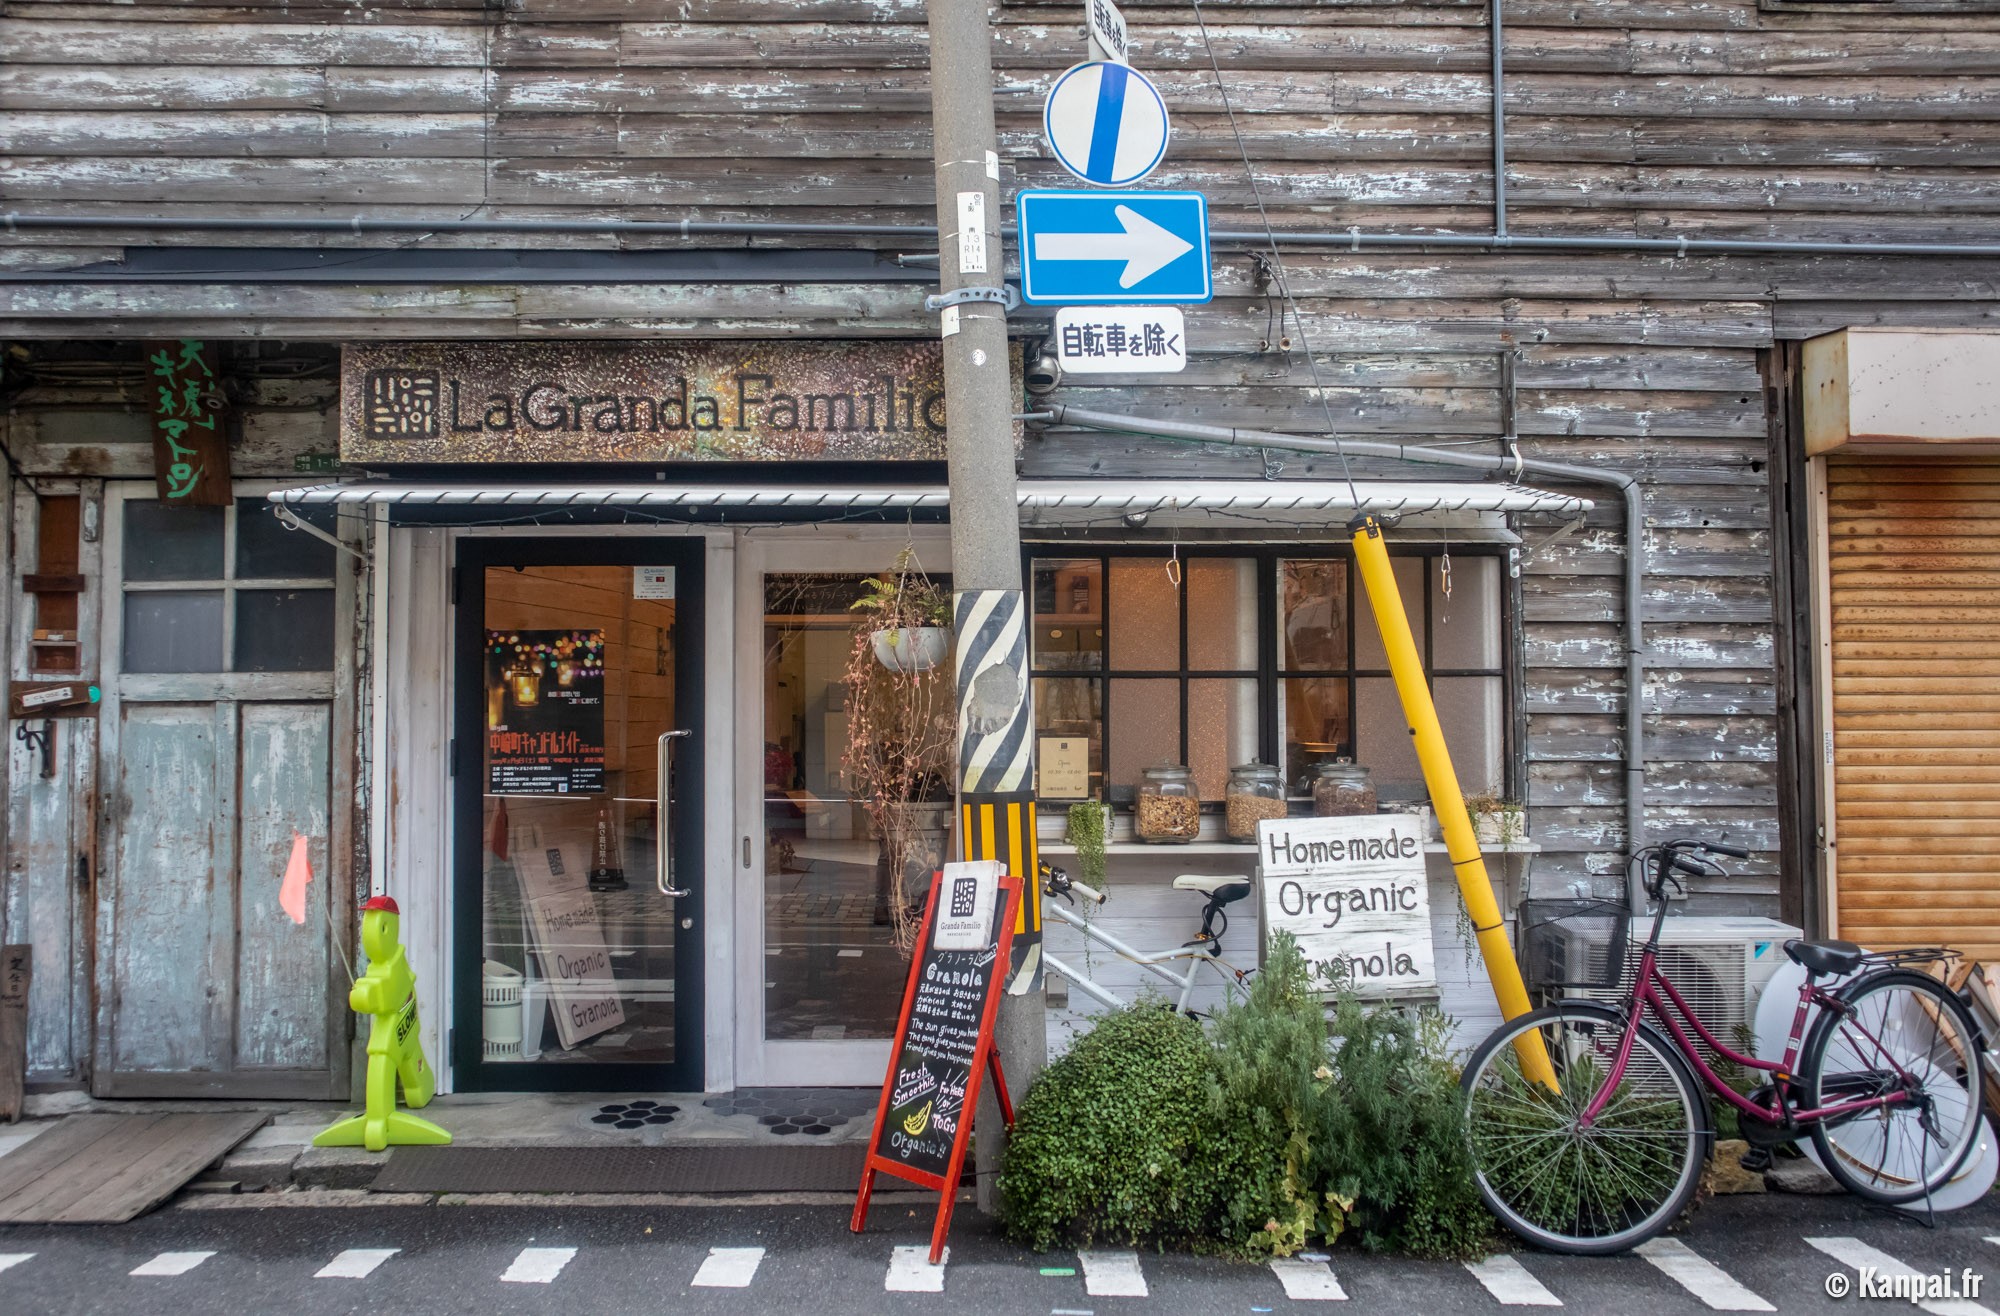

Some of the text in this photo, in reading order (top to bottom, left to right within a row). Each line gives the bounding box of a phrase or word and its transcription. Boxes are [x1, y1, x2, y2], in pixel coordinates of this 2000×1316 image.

[1062, 322, 1181, 358] 自転車を除く
[150, 349, 204, 499] キネマトロン
[1269, 828, 1418, 865] Homemade
[1279, 880, 1418, 928] Organic
[543, 904, 596, 936] Homemade
[941, 921, 960, 930] Granda
[557, 951, 605, 986] Organic
[926, 962, 983, 987] Granola
[1297, 941, 1420, 980] ranola
[571, 995, 619, 1029] Granola
[908, 1031, 920, 1042] The
[934, 1037, 949, 1048] gives
[947, 1040, 957, 1050] you
[911, 1017, 923, 1030] The
[925, 1022, 938, 1031] sun
[939, 1025, 958, 1037] gives
[956, 1029, 967, 1039] you
[905, 1041, 924, 1054] Friends
[923, 1045, 937, 1057] gives
[936, 1050, 947, 1059] you
[899, 1061, 928, 1086] Fresh
[940, 1081, 950, 1094] For
[892, 1075, 935, 1106] Smoothie
[942, 1100, 951, 1108] or
[891, 1131, 937, 1158] Organic
